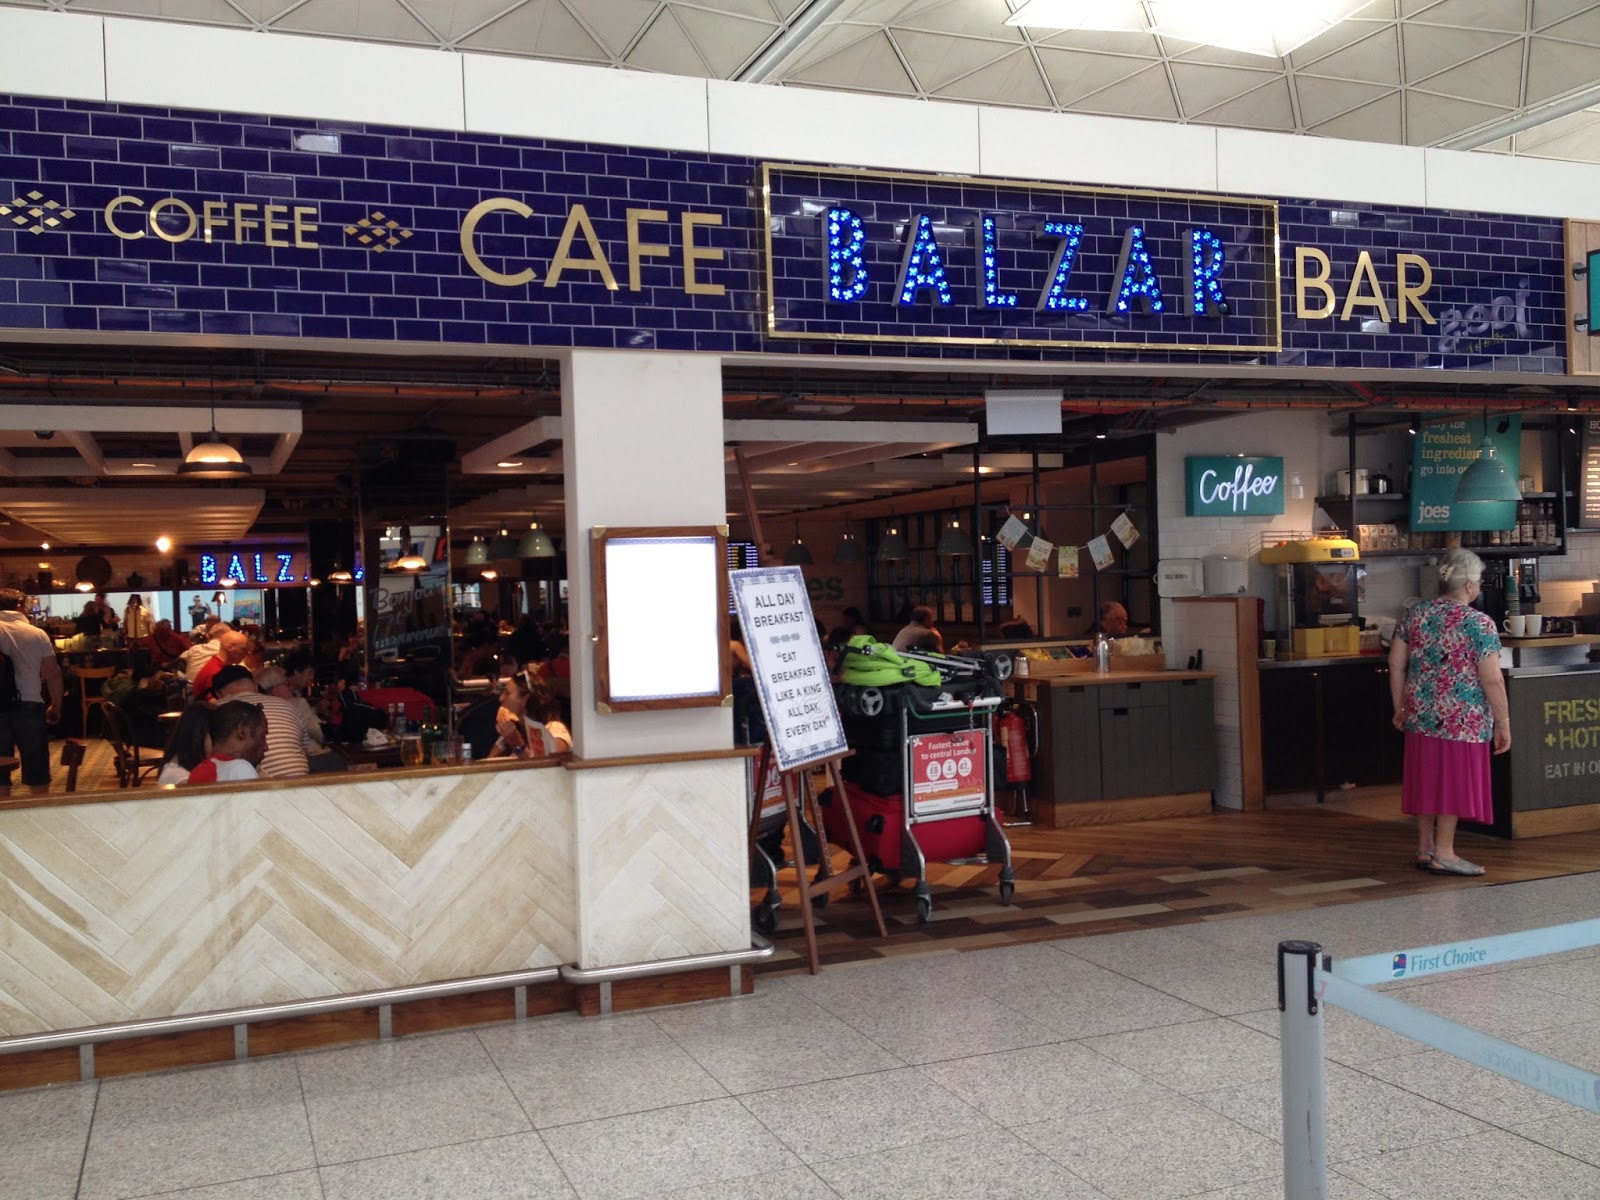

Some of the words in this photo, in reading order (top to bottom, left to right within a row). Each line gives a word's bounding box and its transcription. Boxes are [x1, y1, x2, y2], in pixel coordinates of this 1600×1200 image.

[104, 195, 319, 250] COFFEE
[460, 197, 726, 296] CAFE
[823, 205, 1231, 317] BALZAR
[1294, 246, 1437, 325] BAR
[1422, 431, 1471, 443] freshest
[1421, 447, 1482, 461] ingredien
[1420, 466, 1433, 476] go
[1436, 465, 1456, 474] into
[1199, 463, 1278, 512] Coffee
[1417, 501, 1450, 523] joes
[755, 595, 776, 609] ALL
[777, 592, 796, 606] DAY
[753, 611, 805, 628] BREAKFAST
[771, 666, 817, 684] BREAKFAST
[775, 689, 795, 702] LIKE
[796, 690, 802, 698] A
[802, 686, 822, 698] KING
[788, 706, 804, 718] ALL
[1543, 698, 1600, 724] FRES
[785, 723, 811, 738] EVERY
[1559, 726, 1600, 750] HOT
[928, 741, 951, 750] Fastest
[929, 749, 952, 759] central
[1545, 763, 1570, 778] EAT
[1573, 761, 1586, 775] IN
[1410, 954, 1440, 972] First
[1442, 946, 1487, 967] Choice
